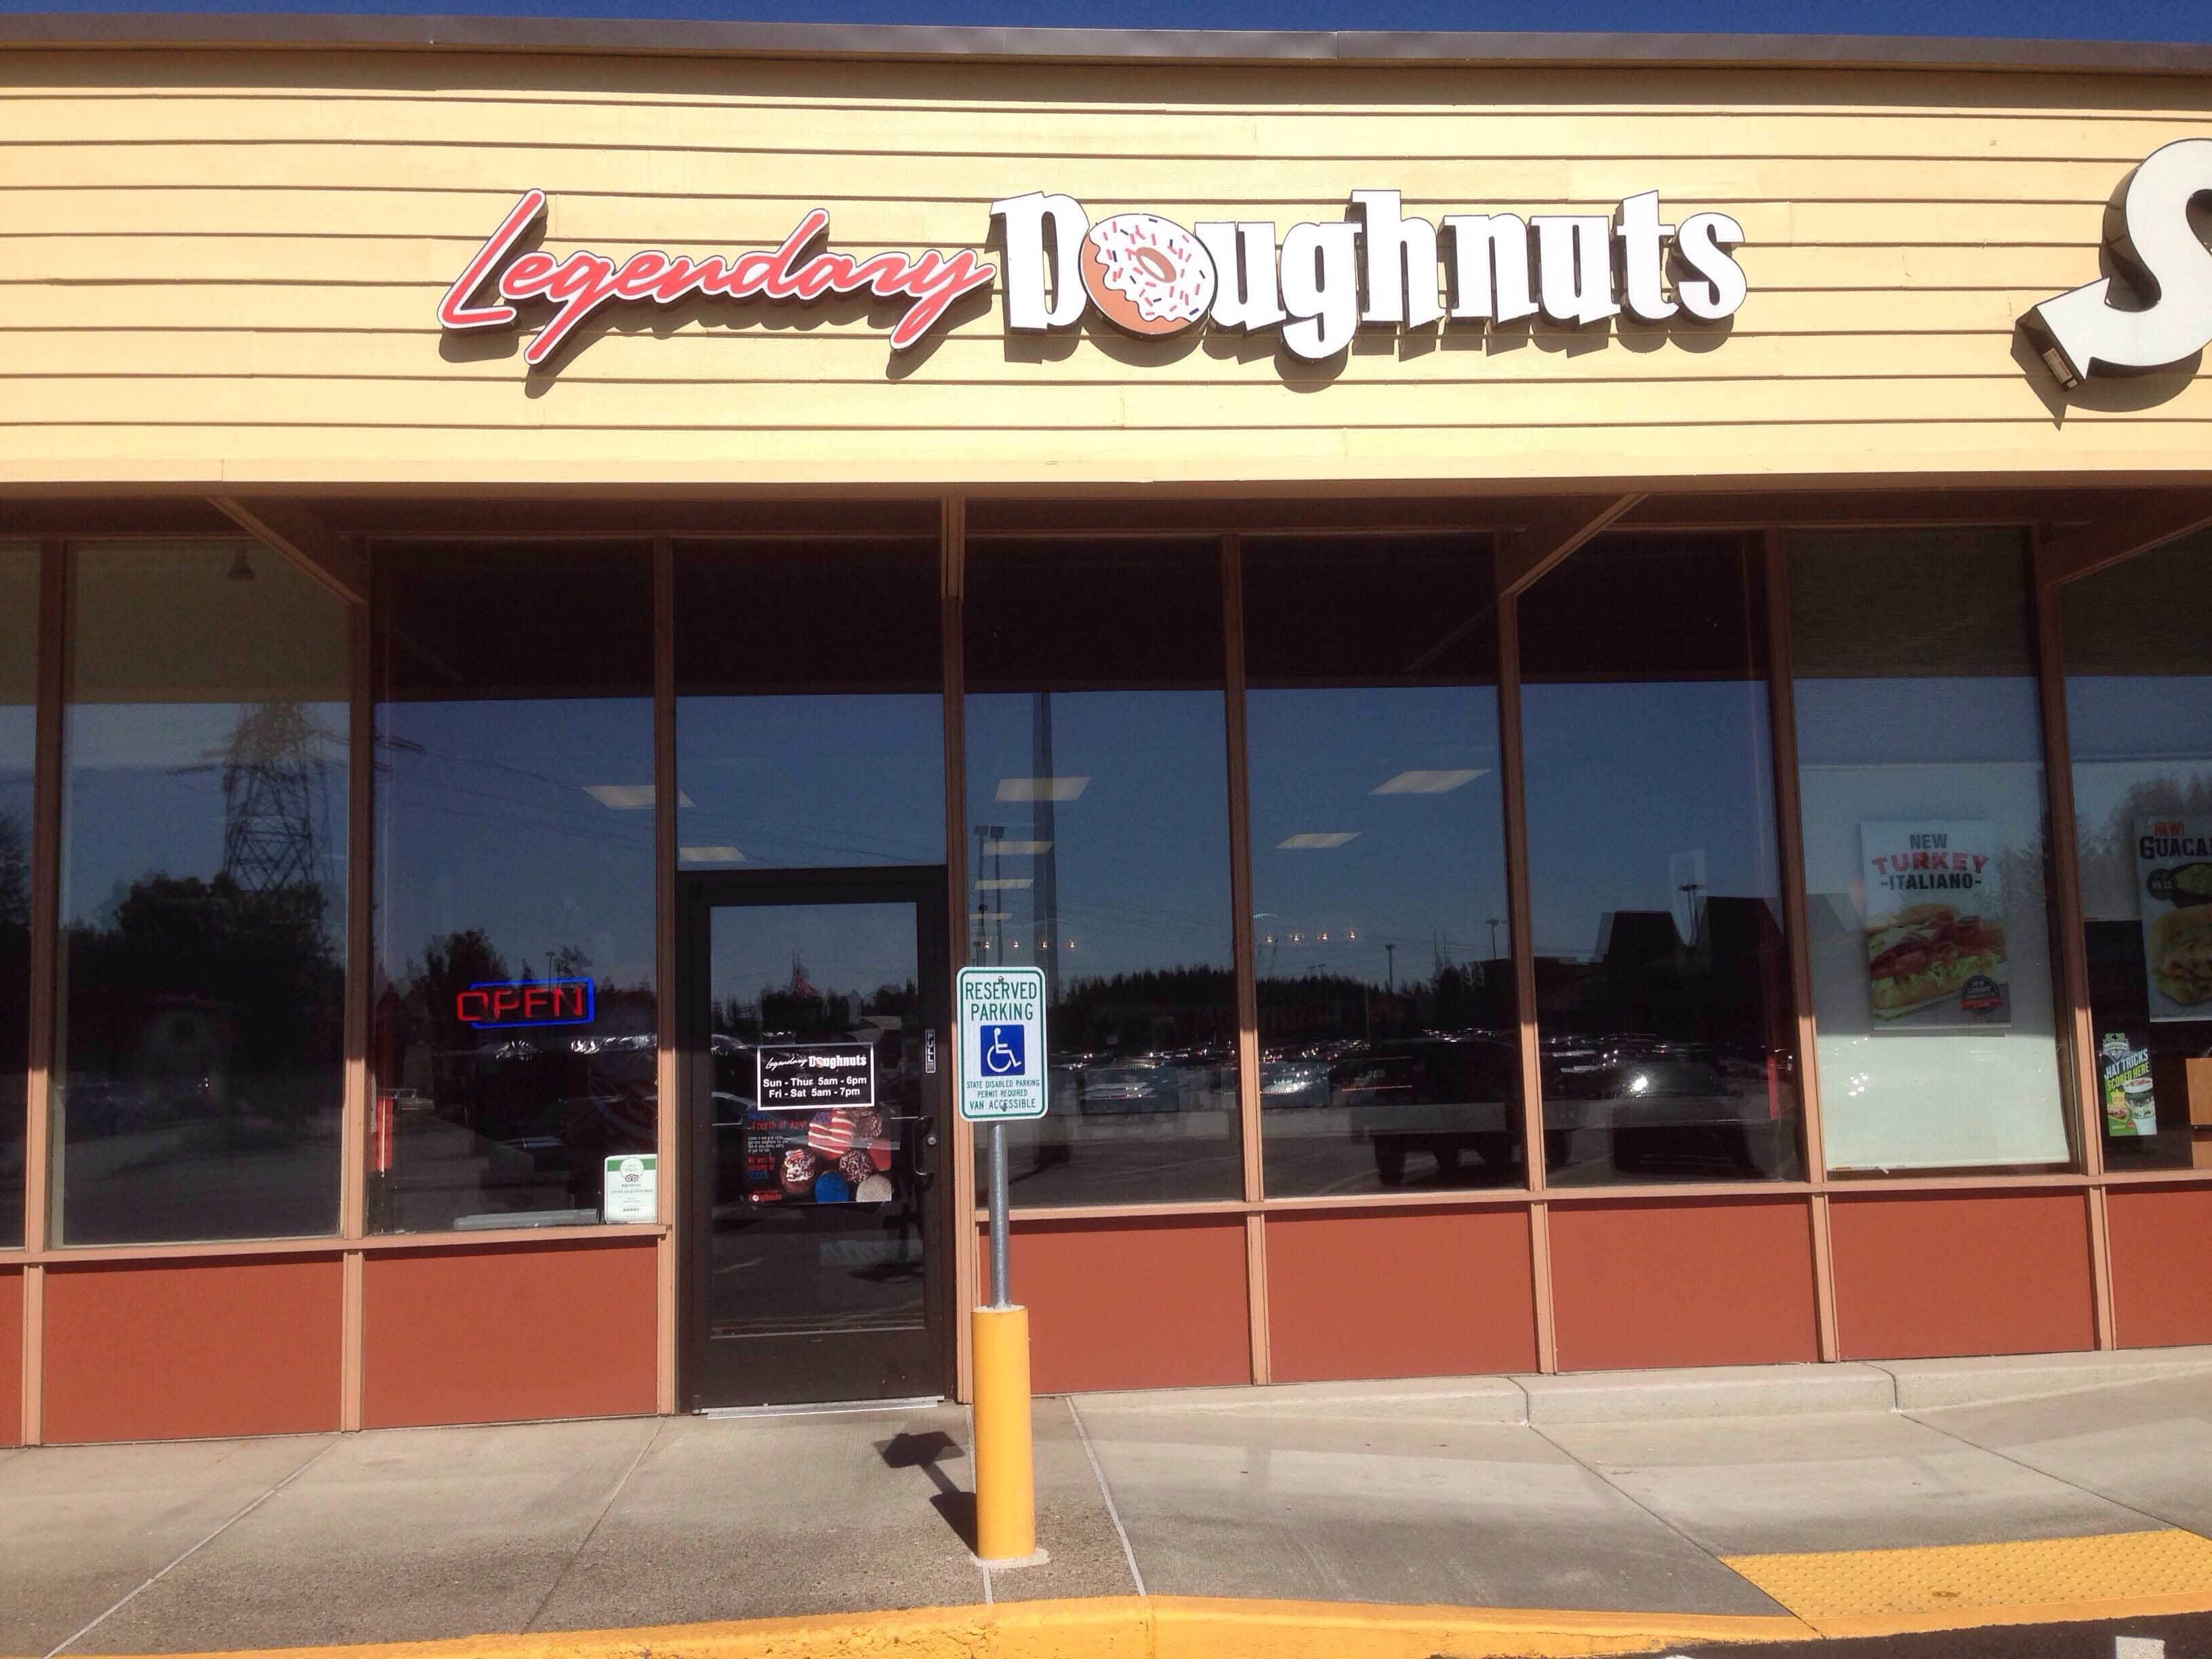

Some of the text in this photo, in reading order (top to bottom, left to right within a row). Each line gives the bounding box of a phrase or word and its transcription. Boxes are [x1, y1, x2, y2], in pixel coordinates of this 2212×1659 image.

[436, 188, 1746, 366] Legendary Doughnuts
[1910, 833, 1947, 849] NEW
[2139, 836, 2211, 859] GUACA
[1871, 851, 1990, 875] TURKEY
[966, 982, 1037, 1000] RESERVED
[457, 986, 583, 1021] OPEN
[971, 1003, 1033, 1021] PARKING
[765, 1054, 867, 1071] Legendary Doughnuts
[2105, 1048, 2149, 1079] HAT TRICKS
[763, 1079, 782, 1088] Sun
[818, 1077, 838, 1086] 5am
[846, 1076, 867, 1086] 6pm
[2107, 1062, 2150, 1091] SCORED HERE
[769, 1089, 782, 1098] Fri
[790, 1088, 806, 1097] Sat
[811, 1088, 832, 1097] 5am
[840, 1087, 861, 1098] 7pm
[970, 1099, 1036, 1110] VAN ACCESSIBLE
